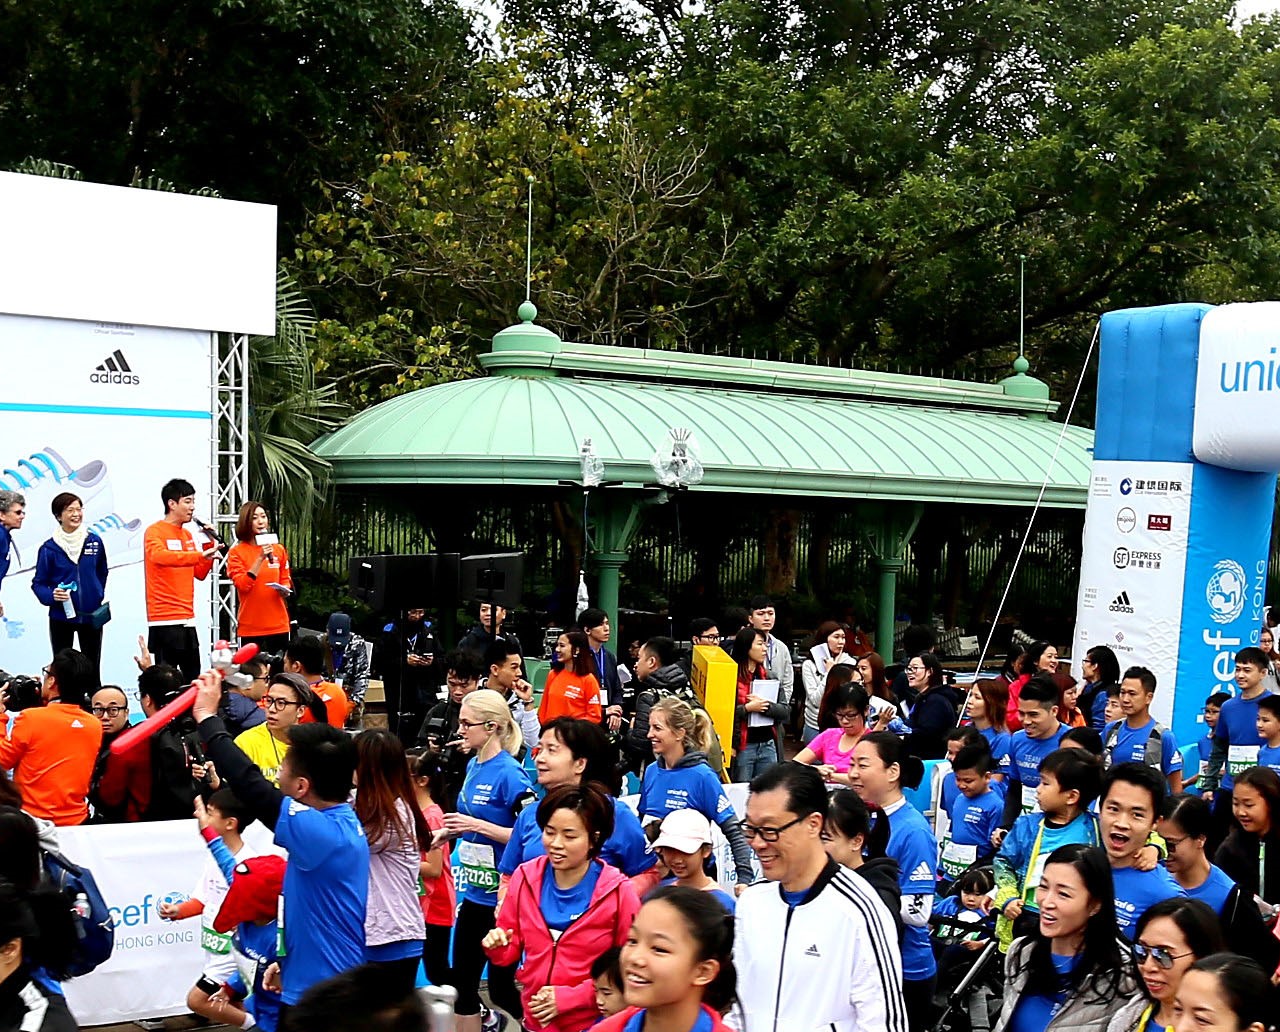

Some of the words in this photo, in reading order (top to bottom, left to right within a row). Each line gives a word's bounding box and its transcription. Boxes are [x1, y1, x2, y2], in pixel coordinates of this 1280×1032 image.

[90, 371, 140, 386] adidas
[1131, 550, 1162, 561] EXPRESS
[1251, 559, 1266, 621] KONG
[1109, 603, 1134, 614] adidas
[116, 934, 153, 950] HONG
[157, 931, 194, 944] KONG
